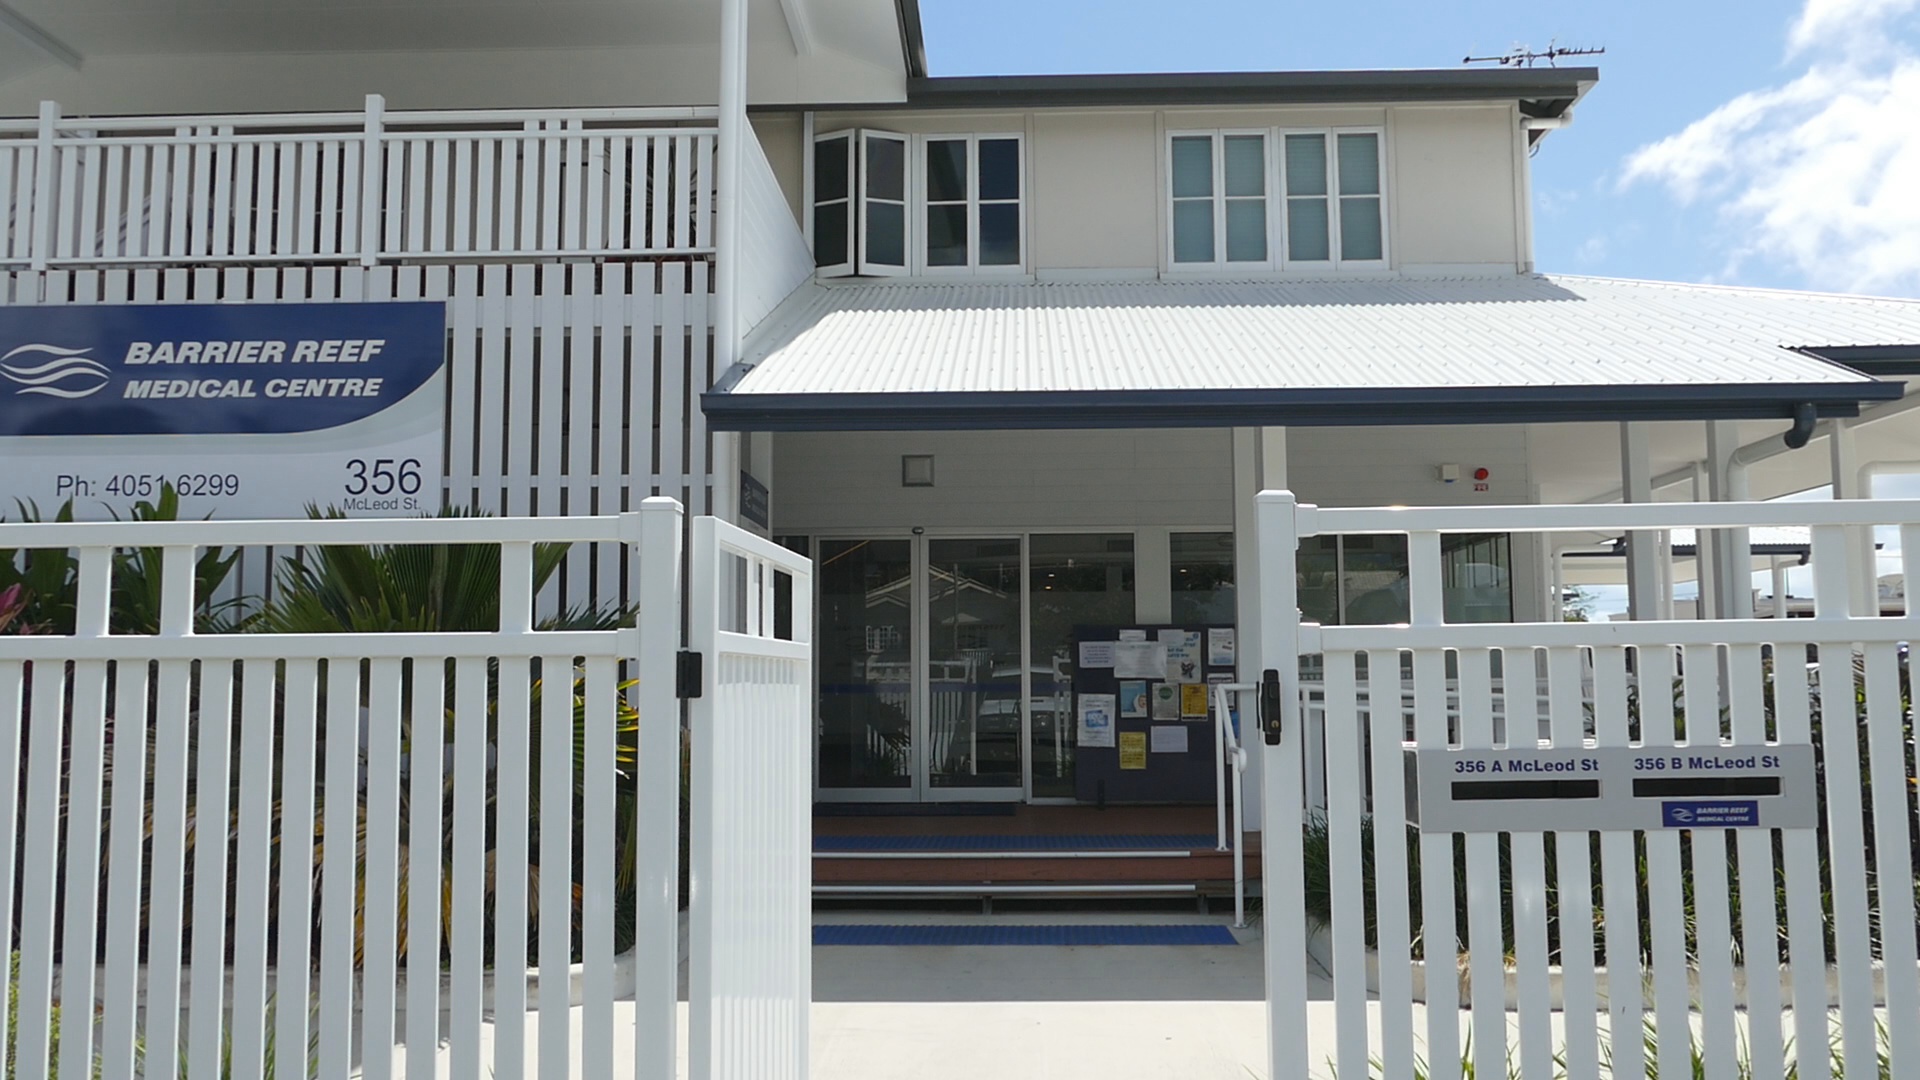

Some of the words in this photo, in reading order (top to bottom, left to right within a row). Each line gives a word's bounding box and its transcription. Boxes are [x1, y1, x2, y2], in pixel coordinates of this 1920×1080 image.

[124, 341, 287, 365] BARRIER
[291, 339, 386, 363] REEF
[123, 379, 257, 399] MEDICAL
[264, 378, 384, 398] CENTRE
[344, 458, 422, 495] 356
[56, 475, 97, 497] Ph:
[105, 474, 166, 497] 4051
[176, 474, 240, 497] 6299
[343, 498, 399, 511] McLeod
[1454, 760, 1487, 774] 356
[1491, 760, 1504, 773] A
[1508, 759, 1576, 773] McLeod
[1580, 758, 1600, 772] St
[1634, 757, 1666, 771] 356
[1671, 757, 1683, 770] B
[1688, 756, 1756, 770] McLeod
[1761, 755, 1780, 769] St
[1696, 807, 1730, 815] BARRIER
[1729, 806, 1750, 815] REEF
[1725, 815, 1750, 823] CENTRE
